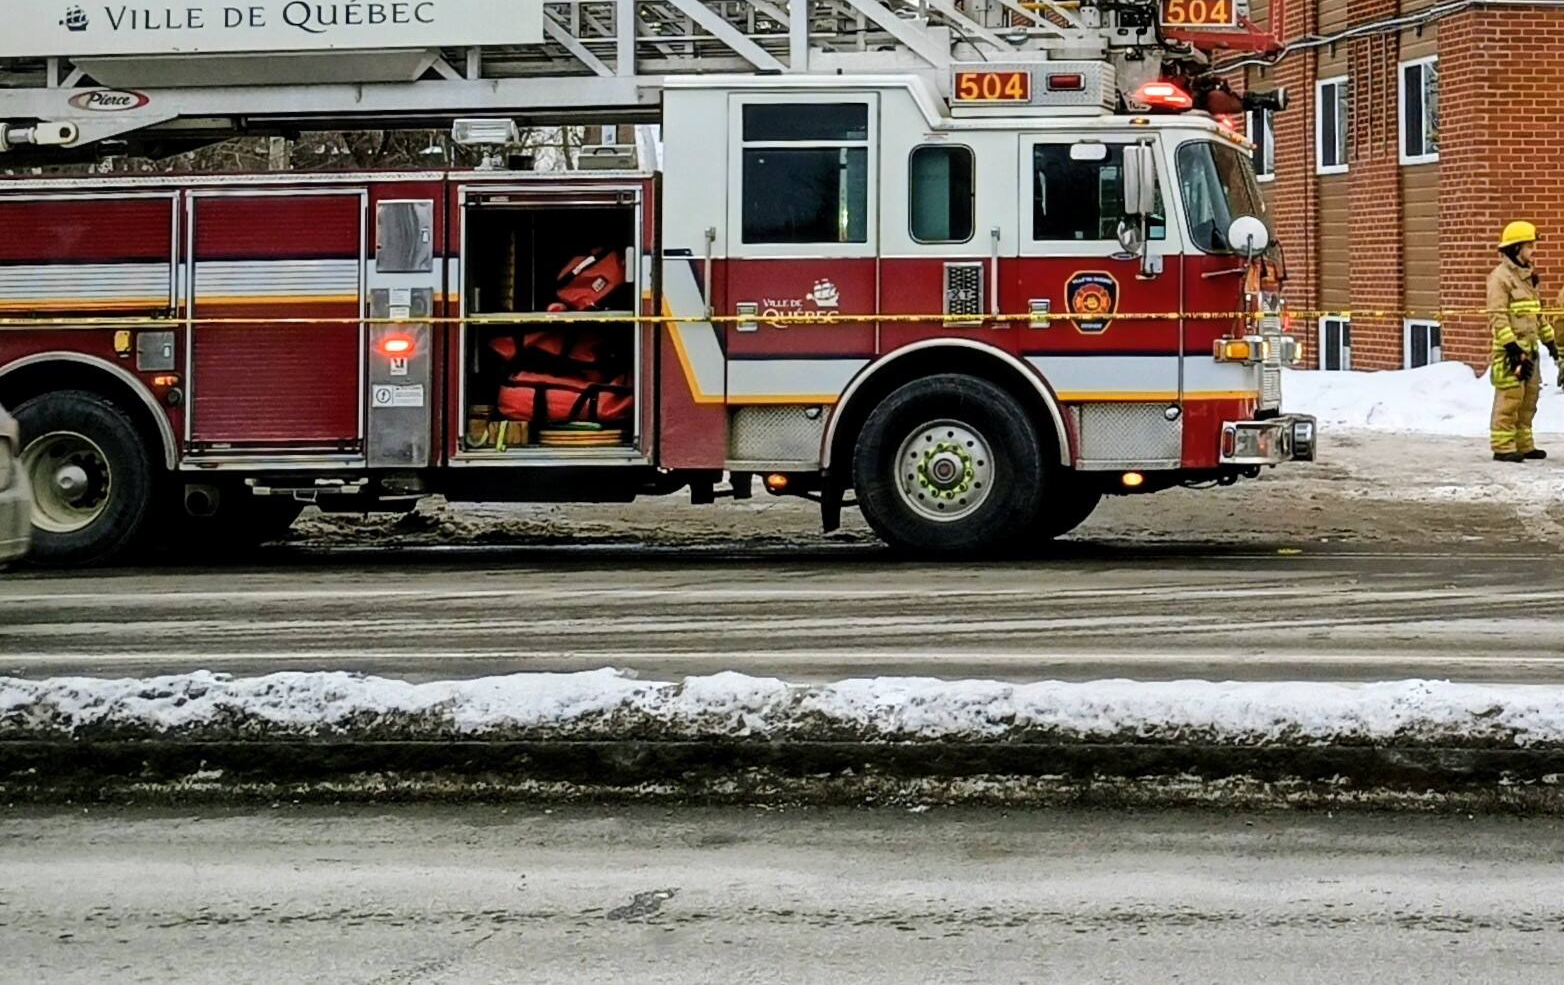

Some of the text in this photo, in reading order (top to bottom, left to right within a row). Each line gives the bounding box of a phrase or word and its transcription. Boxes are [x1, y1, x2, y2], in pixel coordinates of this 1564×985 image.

[223, 6, 266, 28] DE
[959, 72, 1024, 99] 504
[86, 89, 131, 107] Pierce
